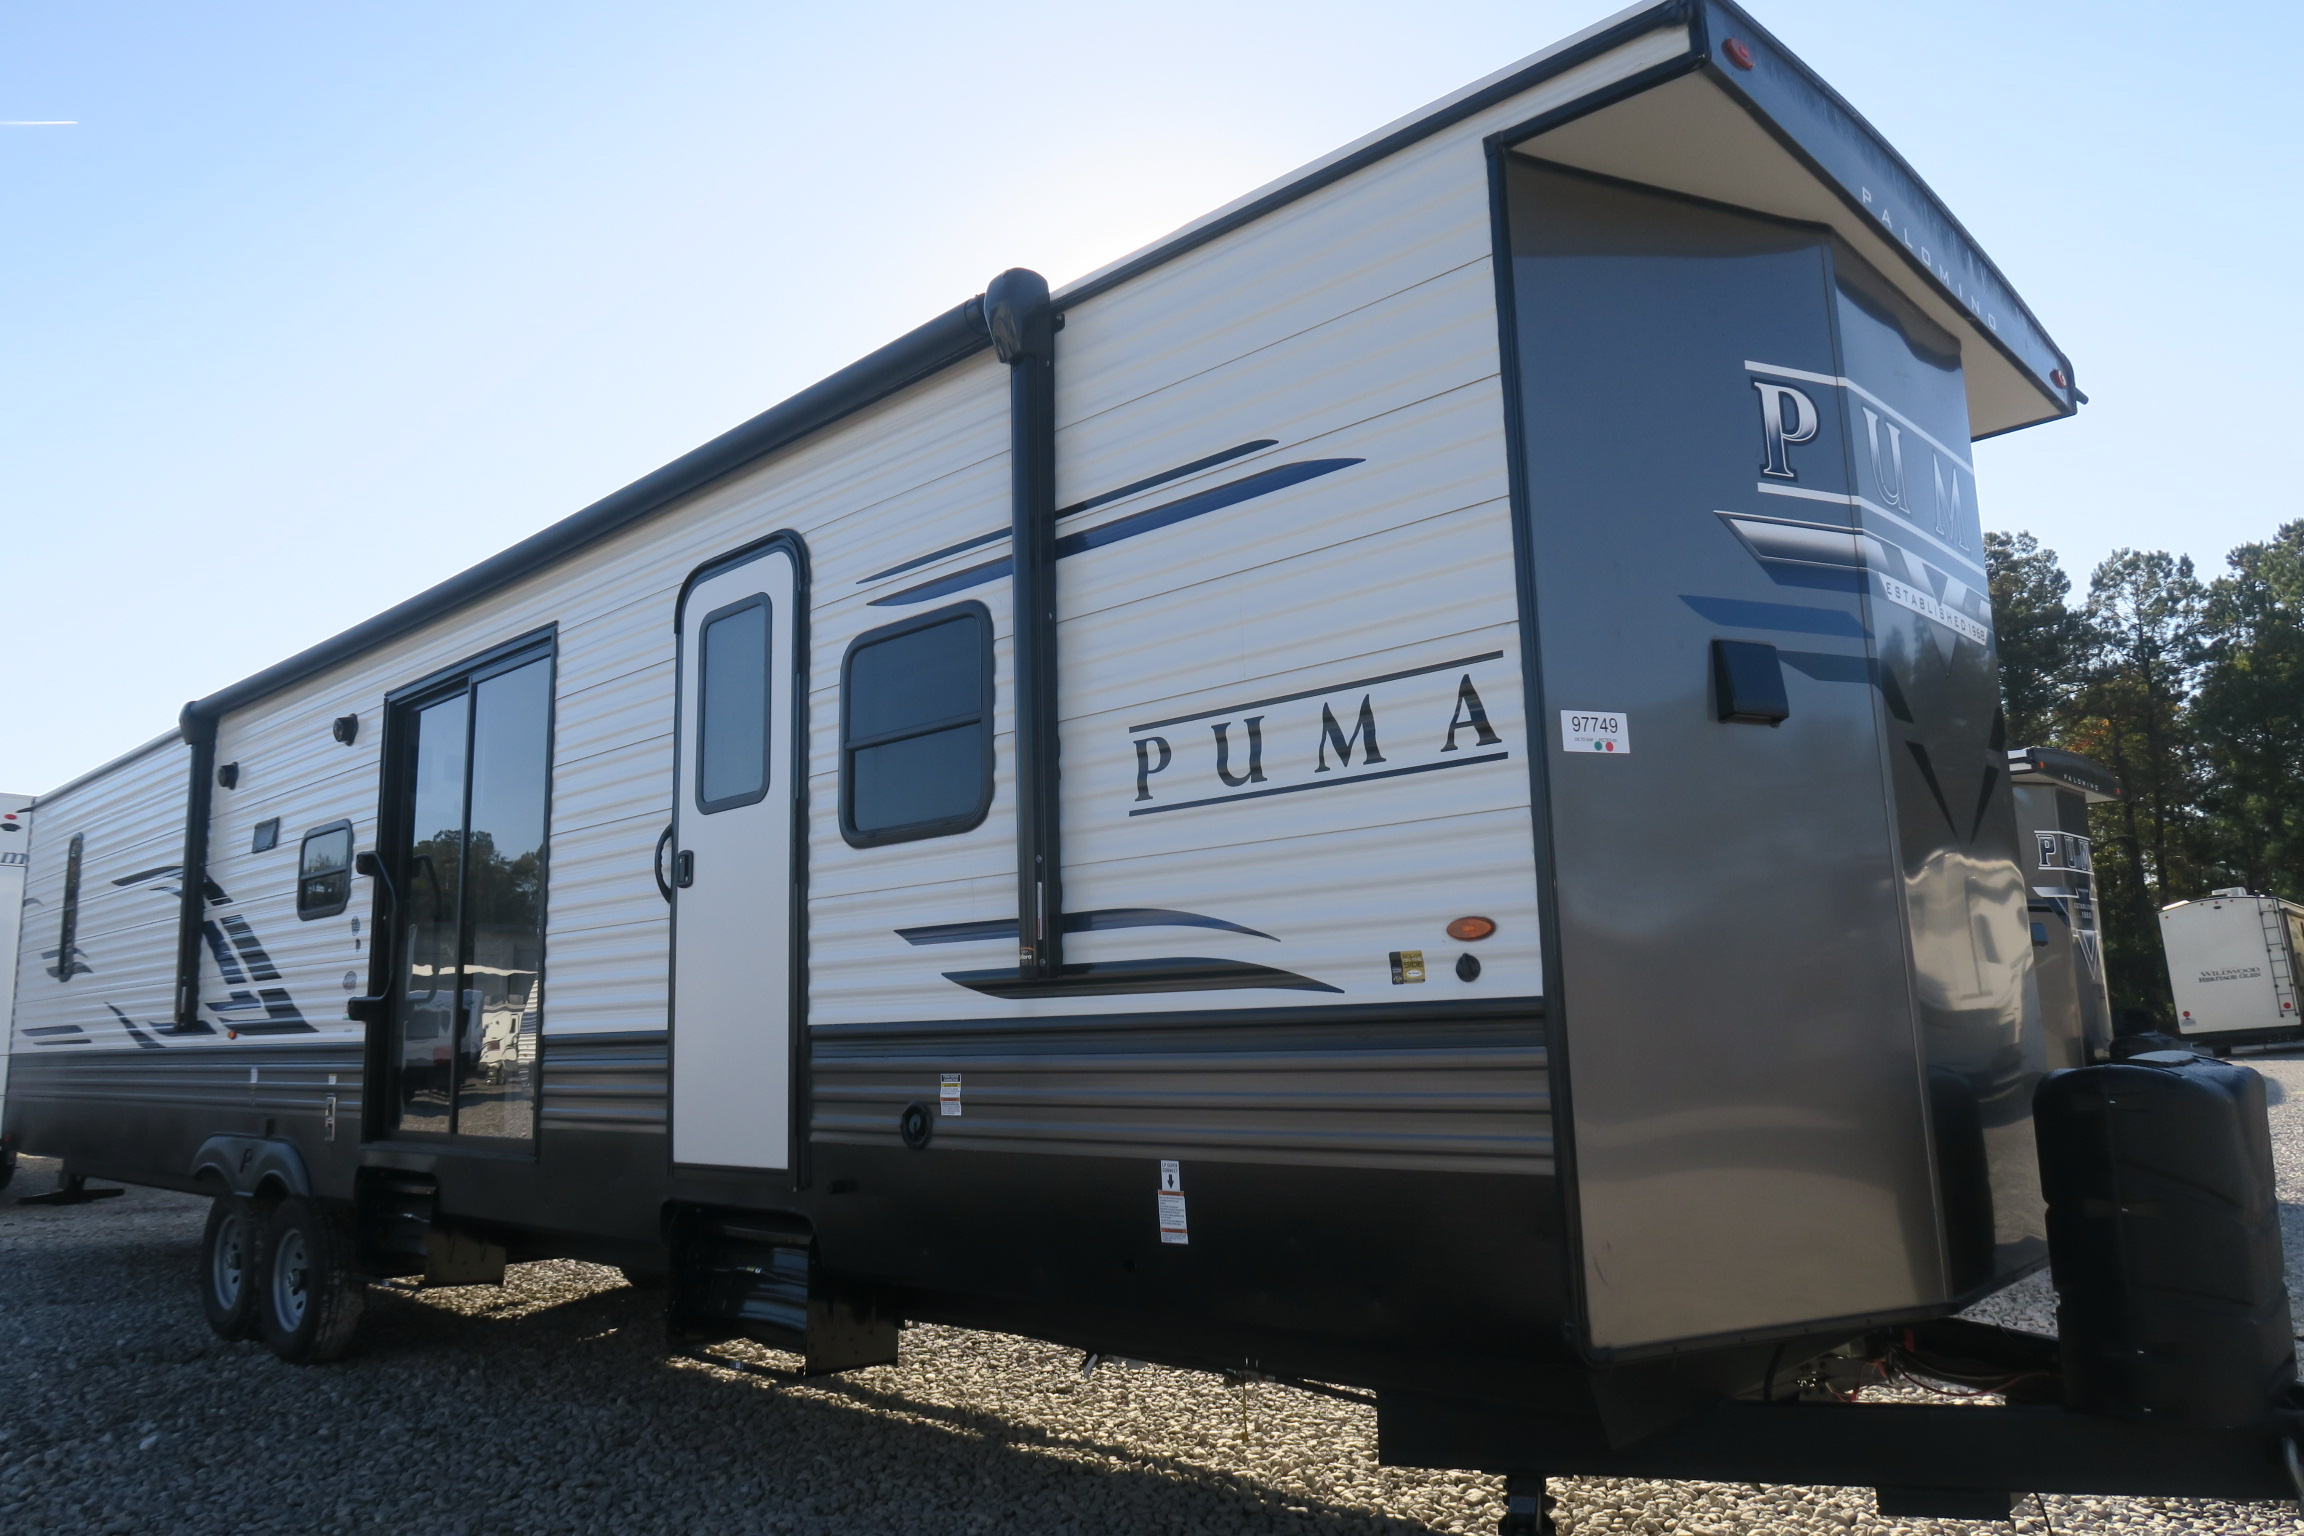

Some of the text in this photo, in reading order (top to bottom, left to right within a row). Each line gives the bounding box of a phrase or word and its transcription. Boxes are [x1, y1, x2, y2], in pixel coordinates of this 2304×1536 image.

[1861, 186, 1997, 331] PALOMINO
[1751, 376, 1971, 552] PUM
[1885, 581, 1967, 632] ESTABLISHED
[1133, 673, 1503, 802] PUMA
[1571, 716, 1619, 734] 97749
[2063, 773, 2099, 791] PALOMINO
